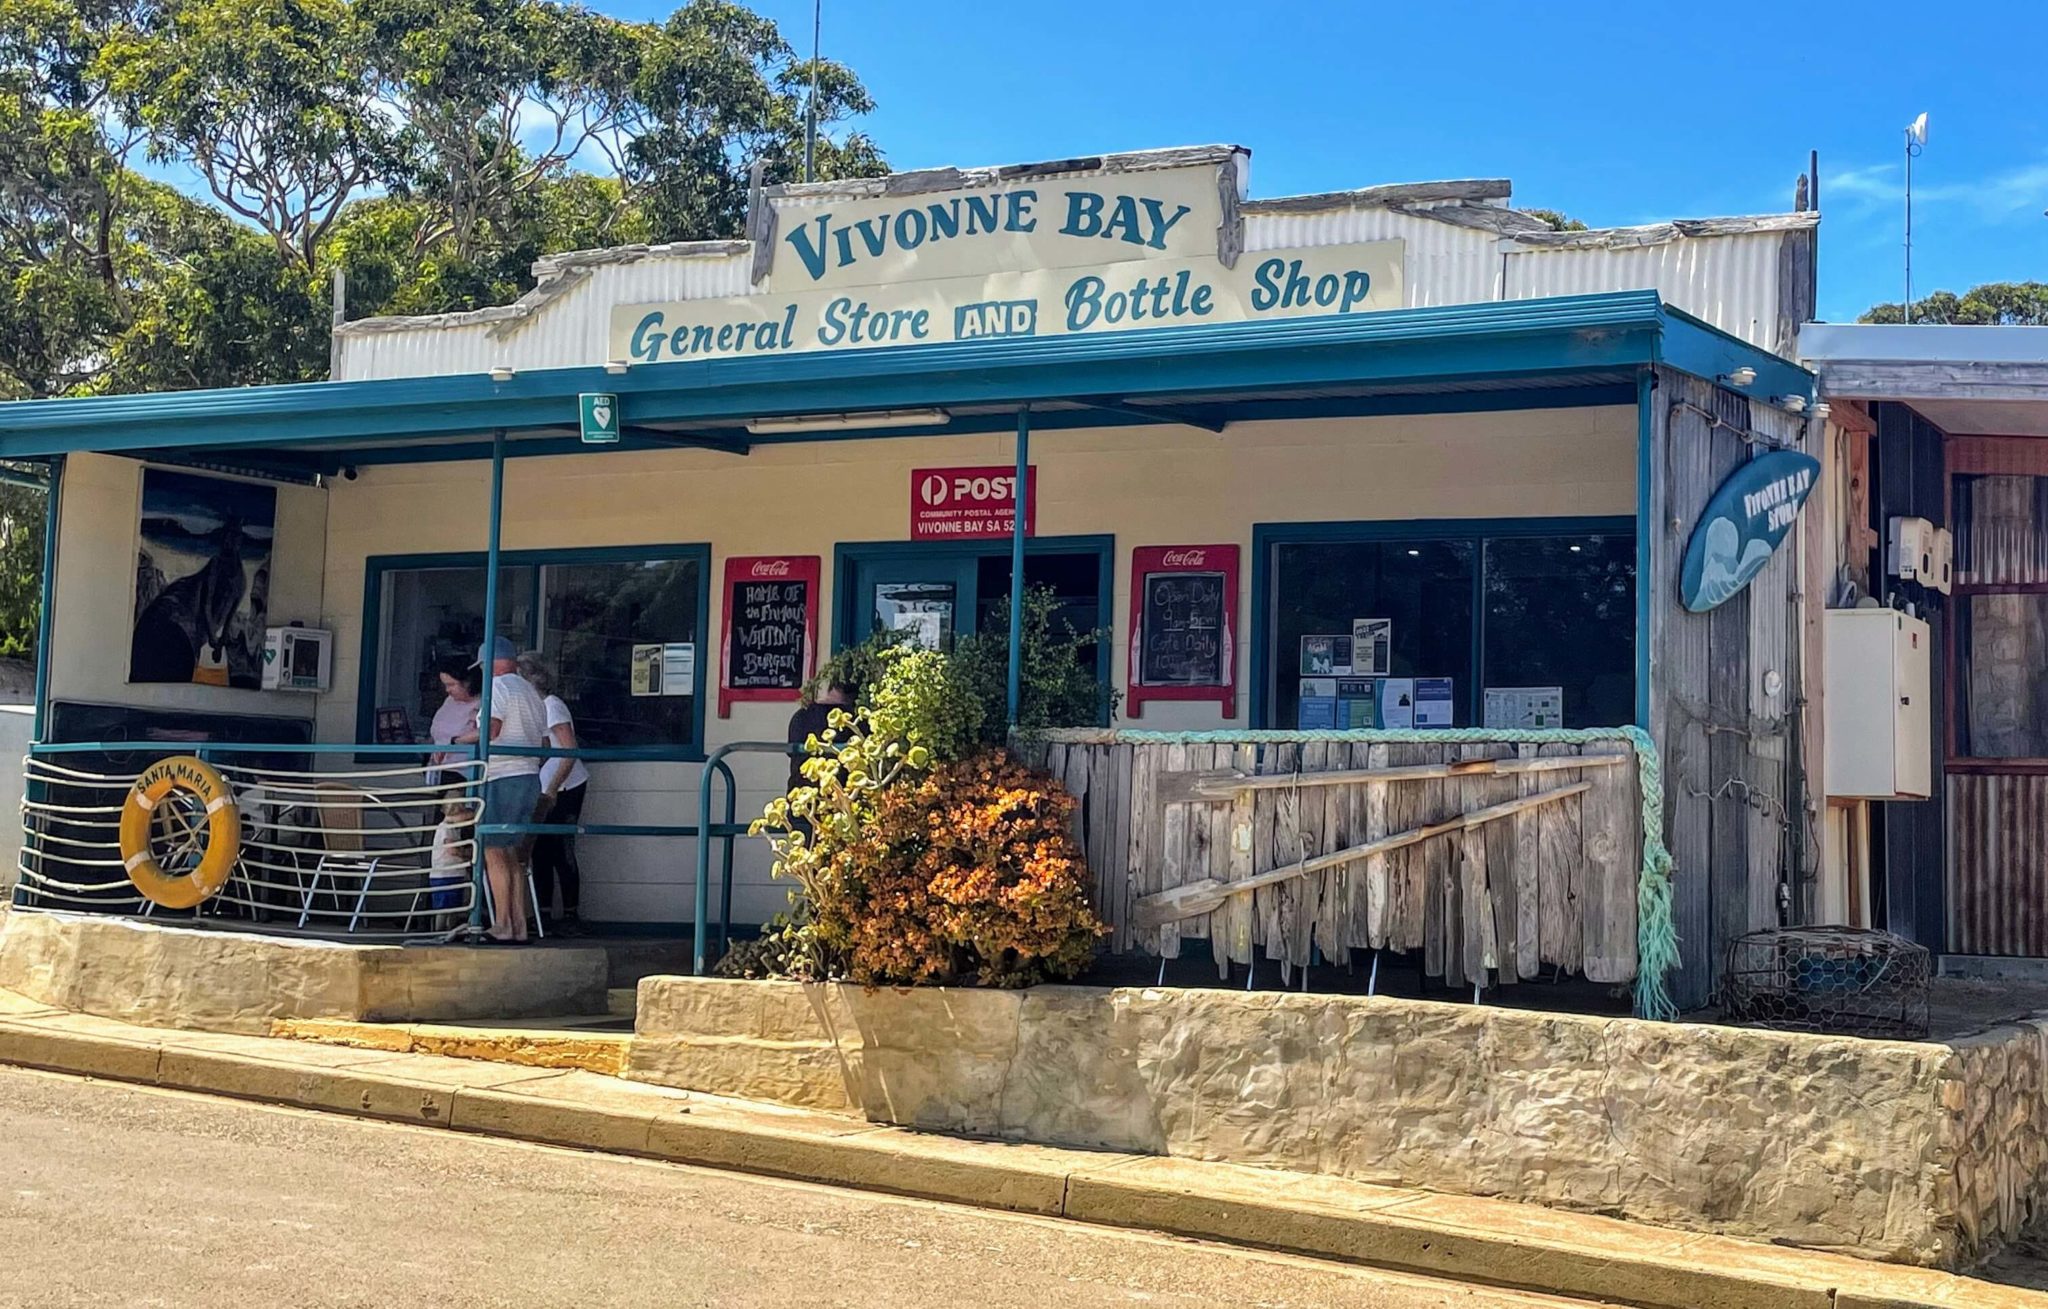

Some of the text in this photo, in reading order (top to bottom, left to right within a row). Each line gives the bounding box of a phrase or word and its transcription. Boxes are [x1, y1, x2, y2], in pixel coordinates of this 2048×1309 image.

[785, 190, 1191, 281] VIVONNE BAY
[630, 258, 1370, 361] General Store AND Bottle Shop
[594, 397, 610, 406] AED
[954, 477, 1017, 500] POST
[1787, 468, 1810, 497] BAY
[920, 510, 962, 518] COMMUNITY
[964, 509, 992, 517] POSTAL
[918, 521, 961, 533] VIVONNE
[964, 520, 984, 532] BAY
[986, 520, 1000, 531] SA
[785, 584, 804, 602] OF
[1154, 583, 1189, 609] Open
[136, 763, 212, 797] SANTA MARIA
